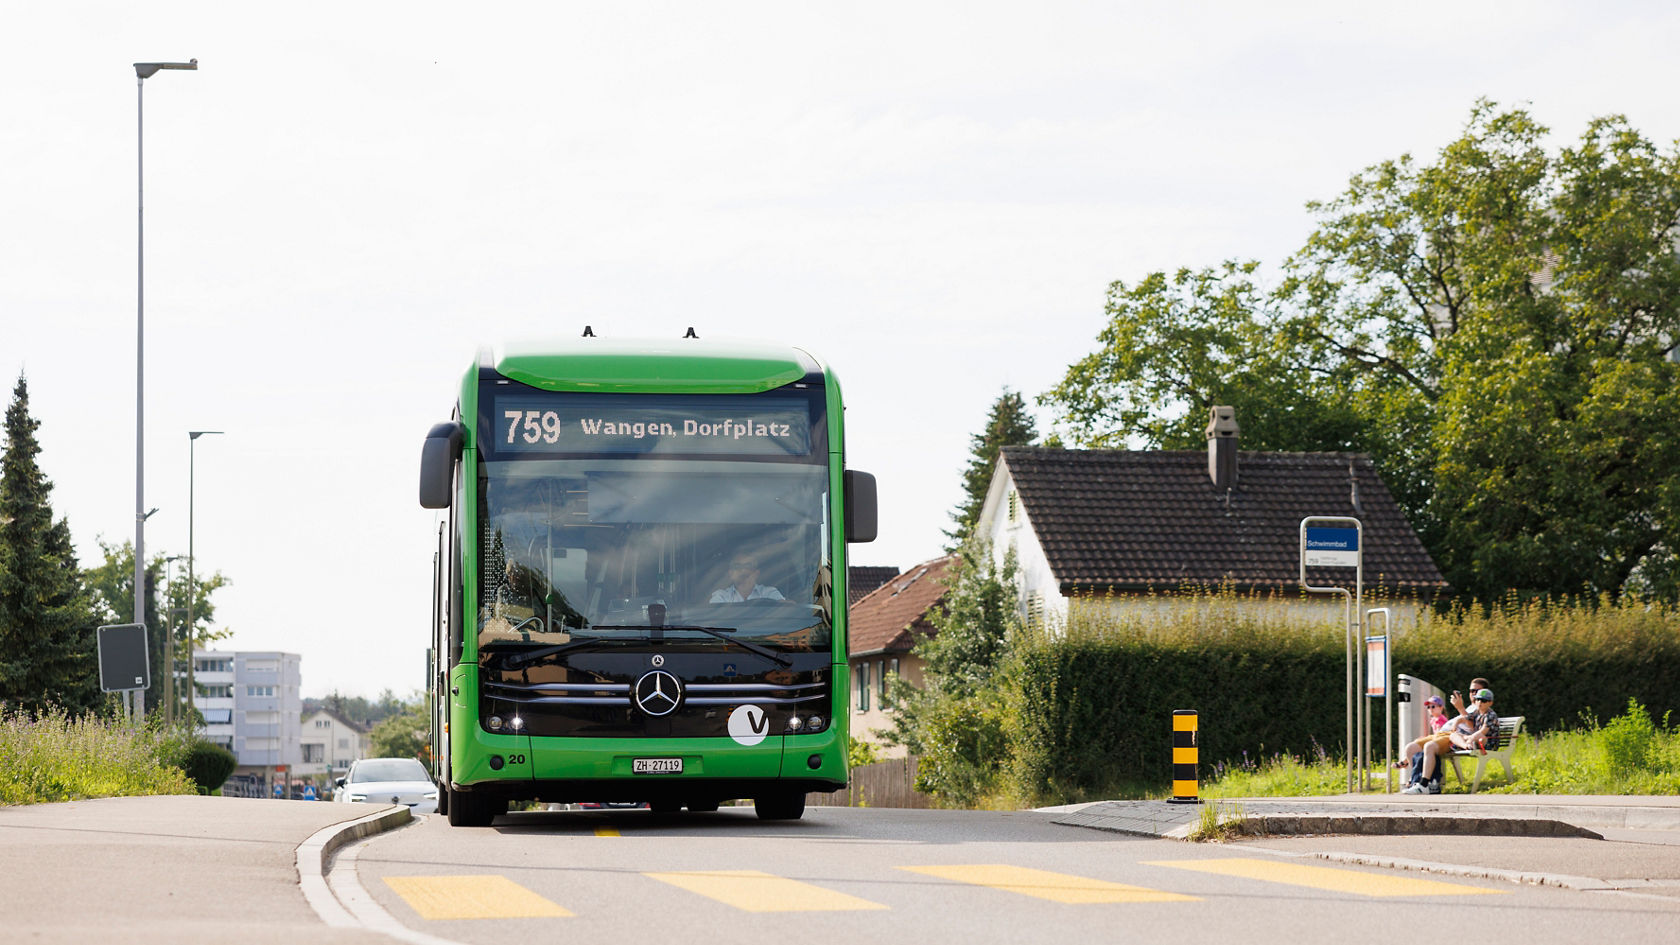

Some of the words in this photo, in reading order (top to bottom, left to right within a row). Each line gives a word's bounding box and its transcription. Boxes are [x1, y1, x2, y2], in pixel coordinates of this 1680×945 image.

[504, 410, 561, 444] 759
[580, 418, 677, 439] Wangen,
[683, 419, 790, 440] Dorfplatz
[1307, 540, 1347, 548] Schwimmbad
[508, 754, 526, 764] 20
